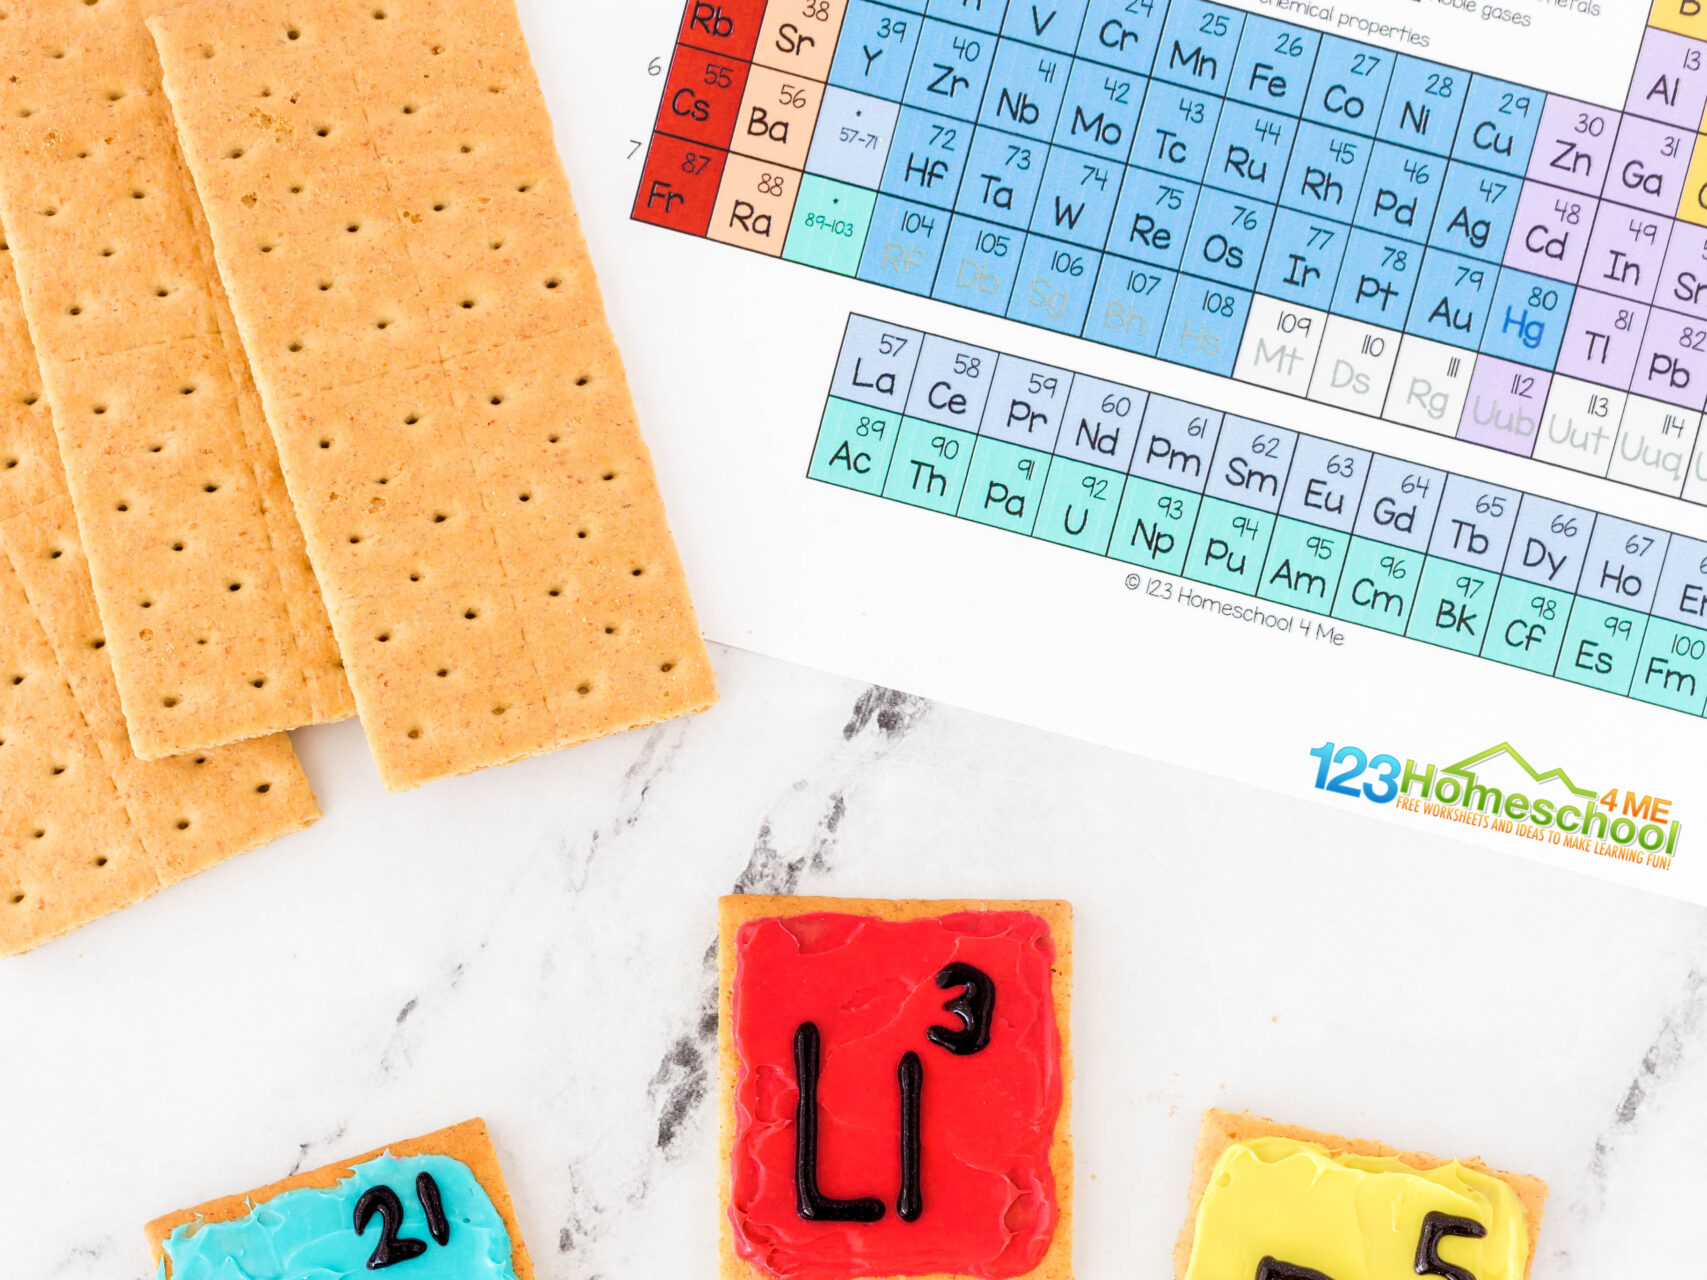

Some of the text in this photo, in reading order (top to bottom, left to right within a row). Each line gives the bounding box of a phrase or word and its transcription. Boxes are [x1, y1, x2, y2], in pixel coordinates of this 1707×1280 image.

[689, 0, 733, 37] Rb
[877, 17, 906, 42] 39
[1031, 5, 1056, 36] V
[1199, 12, 1229, 36] 25
[1337, 12, 1431, 48] properties
[1480, 4, 1532, 27] gases
[775, 23, 814, 55] Sr
[1098, 18, 1138, 51] Cr
[647, 57, 662, 77] 6
[703, 63, 733, 88] 55
[862, 44, 883, 76] Y
[1038, 59, 1056, 83] 41
[1169, 40, 1216, 80] Mn
[1350, 53, 1380, 76] 27
[1682, 48, 1700, 70] 13
[779, 84, 806, 108] 56
[926, 63, 969, 97] Zr
[1248, 62, 1286, 97] Fe
[1646, 74, 1679, 106] Al
[671, 87, 709, 121] Cs
[996, 87, 1039, 124] Nb
[1179, 98, 1204, 123] 43
[1323, 84, 1364, 118] Co
[1399, 100, 1430, 135] Ni
[1498, 93, 1530, 117] 29
[746, 105, 788, 143] Ba
[1070, 105, 1121, 145] Mo
[1472, 120, 1513, 156] Cu
[625, 139, 643, 160] 7
[1005, 144, 1030, 170] 73
[1156, 128, 1186, 163] Tc
[1329, 139, 1356, 164] 45
[1549, 139, 1591, 176] Zn
[1660, 136, 1680, 157] 31
[681, 152, 711, 175] 87
[904, 152, 948, 187] Hf
[1224, 144, 1266, 182] Ru
[1622, 159, 1662, 196] Ga
[646, 179, 684, 213] Fr
[757, 173, 783, 196] 88
[980, 173, 1013, 210] Ta
[1156, 185, 1183, 209] 75
[1300, 166, 1342, 204] Rh
[1479, 179, 1507, 203] 47
[729, 199, 771, 237] Ra
[900, 210, 934, 237] 104
[1054, 195, 1085, 229] W
[1373, 187, 1417, 226] Pd
[975, 230, 1010, 257] 105
[1129, 212, 1170, 249] Re
[1306, 225, 1334, 249] 77
[1446, 206, 1490, 248] Ag
[1525, 224, 1568, 260] Cd
[1628, 219, 1657, 244] 49
[1203, 234, 1243, 268] Os
[1603, 249, 1640, 285] In
[1126, 270, 1161, 295] 107
[1282, 253, 1320, 287] Ir
[1454, 266, 1484, 291] 79
[1201, 289, 1234, 317] 108
[1355, 274, 1398, 311] Pt
[1427, 296, 1472, 332] Au
[1502, 305, 1544, 349] Hg
[1614, 309, 1634, 331] 81
[879, 333, 907, 356] 57
[851, 357, 895, 395] La
[1028, 372, 1057, 398] 59
[1648, 352, 1689, 388] Pb
[928, 381, 966, 414] Ce
[856, 416, 885, 440] 89
[1006, 398, 1047, 432] Pr
[1075, 417, 1119, 456] Nd
[828, 440, 871, 473] Ac
[1146, 434, 1200, 476] Pm
[1326, 454, 1353, 477] 63
[910, 459, 946, 496] Th
[1225, 456, 1277, 496] Sm
[984, 480, 1025, 517] Pa
[1157, 496, 1182, 519] 93
[1303, 478, 1344, 514] Eu
[1475, 494, 1505, 517] 65
[1064, 504, 1088, 535] U
[1373, 496, 1416, 533] Gd
[1130, 518, 1174, 559] Np
[1306, 536, 1333, 559] 95
[1451, 518, 1488, 554] Tb
[1625, 534, 1654, 556] 67
[1204, 537, 1246, 575] Pu
[1522, 537, 1567, 580] Dy
[1269, 558, 1325, 597] Am
[1456, 576, 1484, 598] 97
[1599, 559, 1641, 596] Ho
[1146, 578, 1172, 600] 123
[1178, 587, 1293, 633] Homeschool
[1299, 618, 1312, 638] 4
[1316, 623, 1344, 646] Me
[1351, 577, 1403, 616] Cm
[1435, 598, 1477, 635] Bk
[1604, 616, 1632, 640] 99
[1504, 619, 1546, 650] Cf
[1671, 634, 1705, 659] 100
[1574, 639, 1612, 673] Es
[1644, 656, 1695, 695] Fm
[1600, 788, 1619, 813] 4
[1621, 791, 1672, 825] ME
[1395, 795, 1672, 872] FREE WORKSHEETS AND IDEAS TO MAKE LEARNING FUN!
[926, 962, 997, 1056] 3
[352, 1171, 450, 1270] 21
